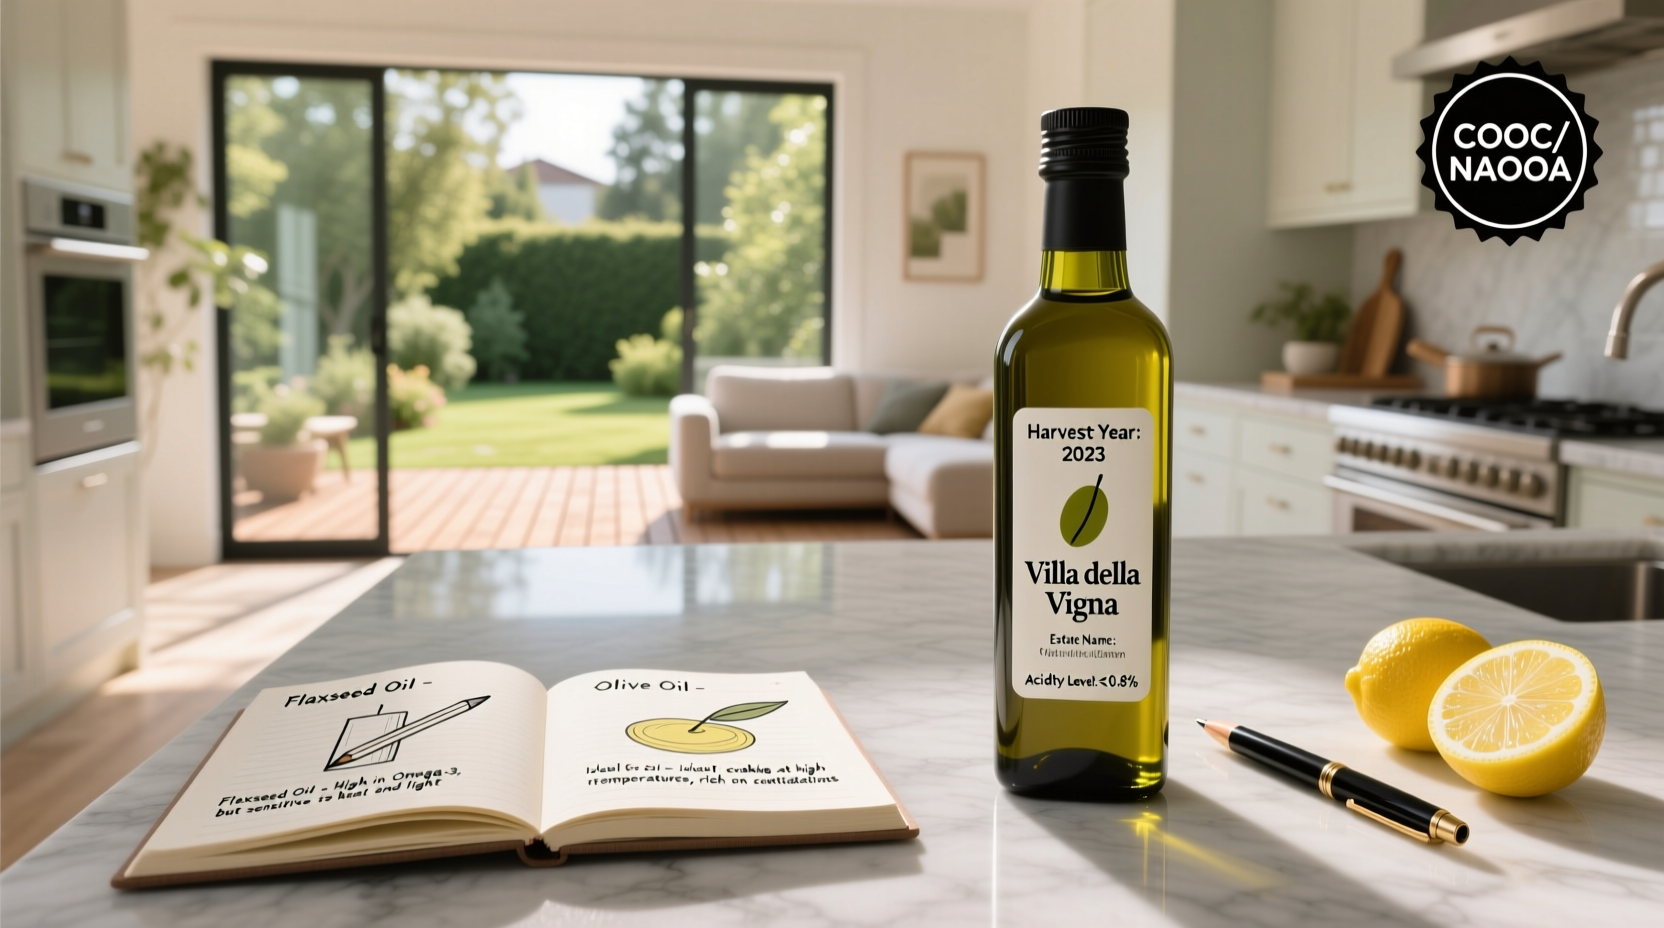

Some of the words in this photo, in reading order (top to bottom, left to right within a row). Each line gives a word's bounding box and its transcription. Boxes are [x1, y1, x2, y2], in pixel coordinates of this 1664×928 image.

[1027, 423, 1095, 440] Harvest
[1097, 424, 1141, 440] Year:
[1061, 445, 1106, 462] 2023
[1024, 559, 1080, 586] Villa
[1083, 559, 1142, 586] della
[1044, 590, 1120, 623] Vigna
[1081, 633, 1117, 646] Name:
[284, 682, 378, 708] Flaxseed
[384, 677, 416, 693] Oil
[593, 678, 651, 692] Olive
[659, 680, 689, 692] Oil
[292, 784, 316, 797] Oil
[333, 776, 368, 791] High
[372, 775, 386, 784] in
[699, 774, 726, 785] rich
[214, 807, 242, 818] but
[374, 781, 402, 794] and
[406, 778, 443, 792] light
